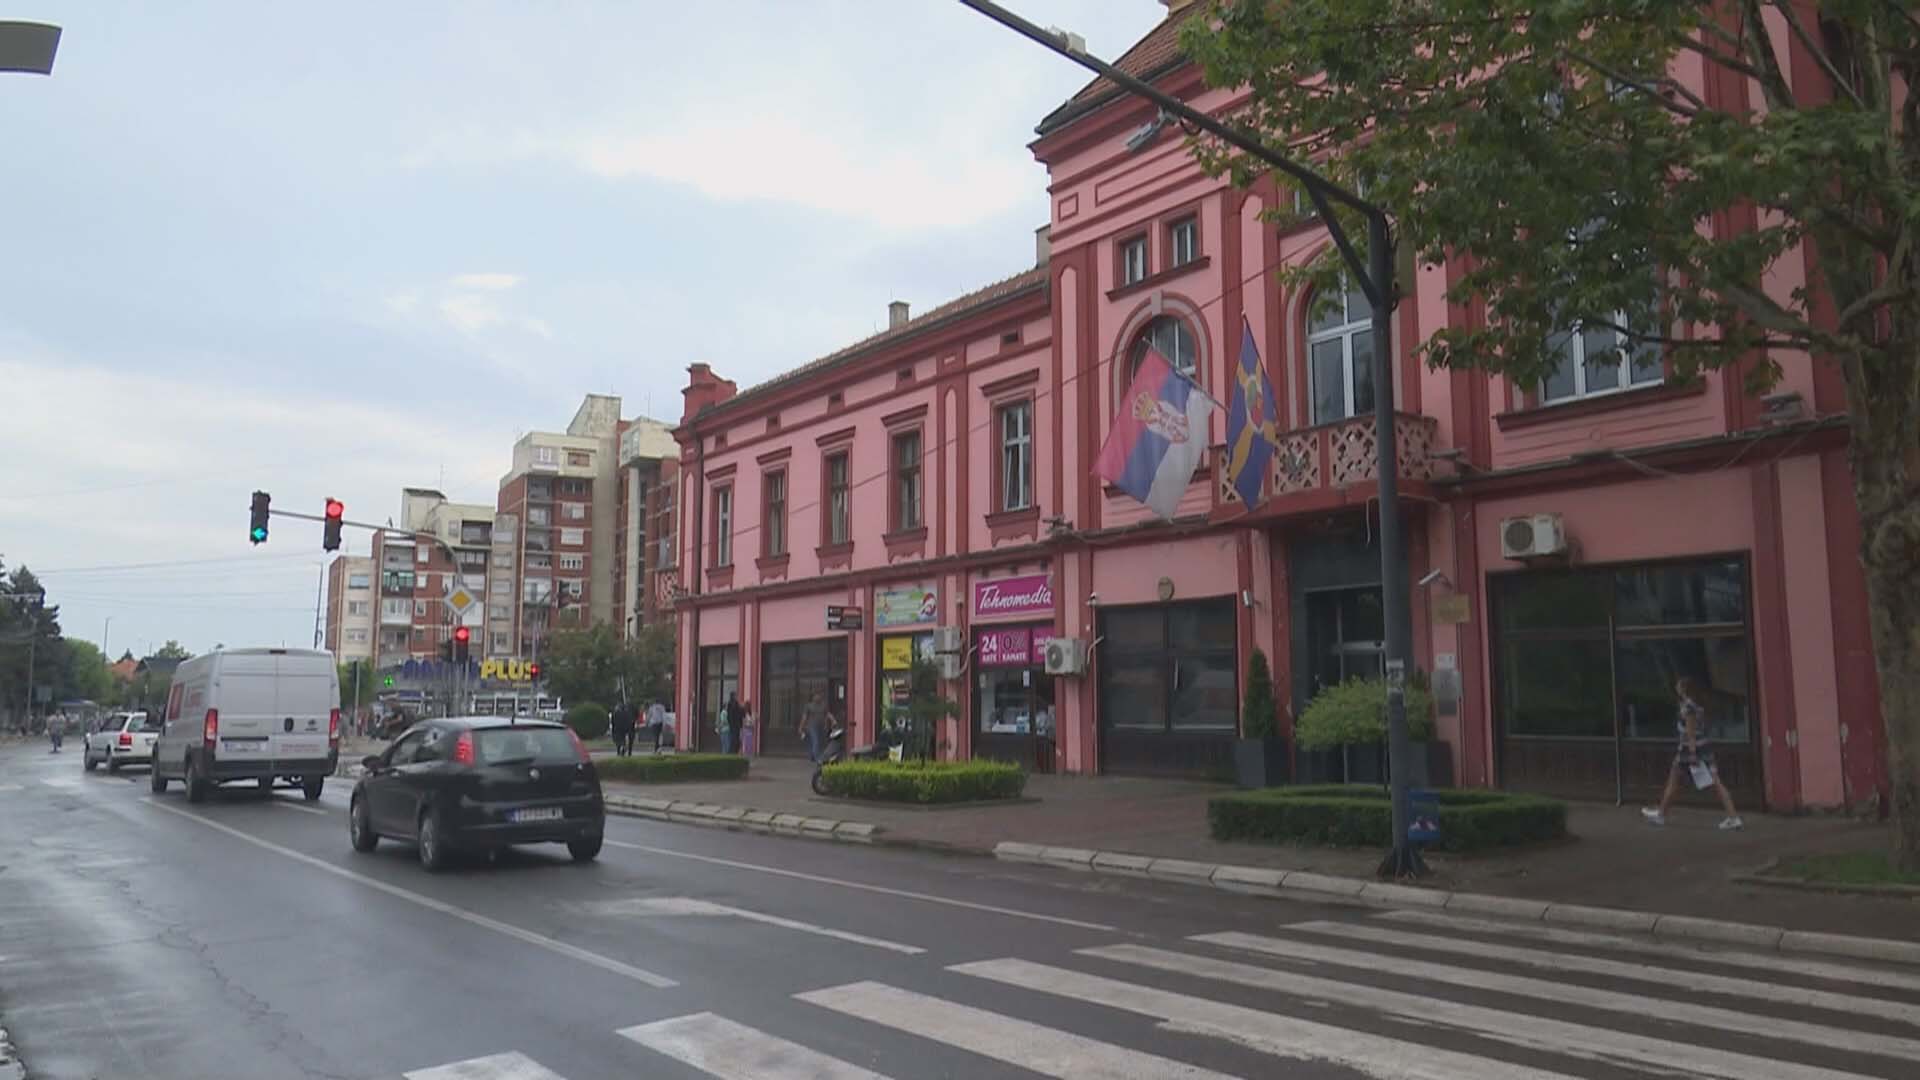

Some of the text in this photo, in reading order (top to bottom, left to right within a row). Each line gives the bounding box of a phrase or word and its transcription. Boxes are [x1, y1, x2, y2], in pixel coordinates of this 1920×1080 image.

[980, 584, 1052, 610] Tehnomedia
[982, 634, 998, 653] 24
[481, 657, 532, 680] PLUS
